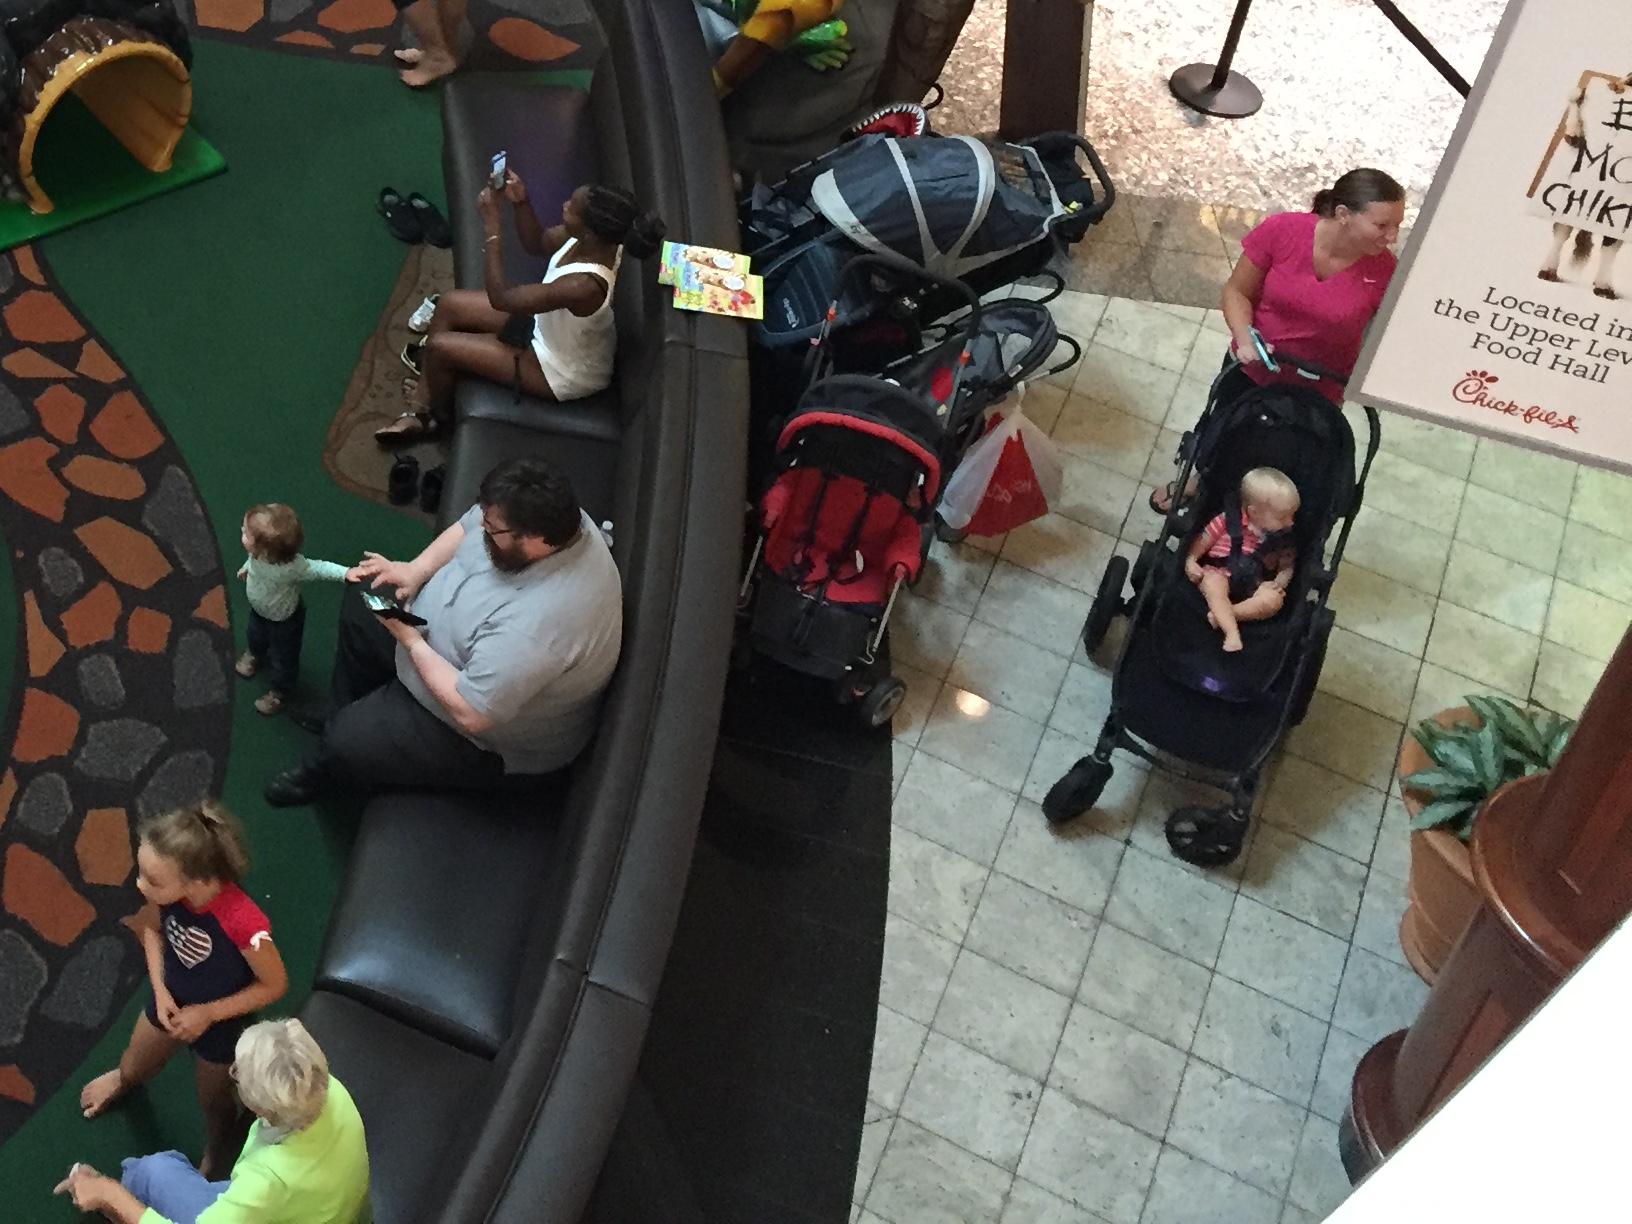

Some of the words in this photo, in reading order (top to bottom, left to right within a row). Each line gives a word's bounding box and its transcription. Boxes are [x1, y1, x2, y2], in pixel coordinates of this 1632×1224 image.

[1433, 298, 1480, 325] the
[1489, 312, 1581, 351] Upper
[1482, 286, 1600, 333] Located
[1470, 331, 1543, 366] Food
[1548, 353, 1610, 384] Hall
